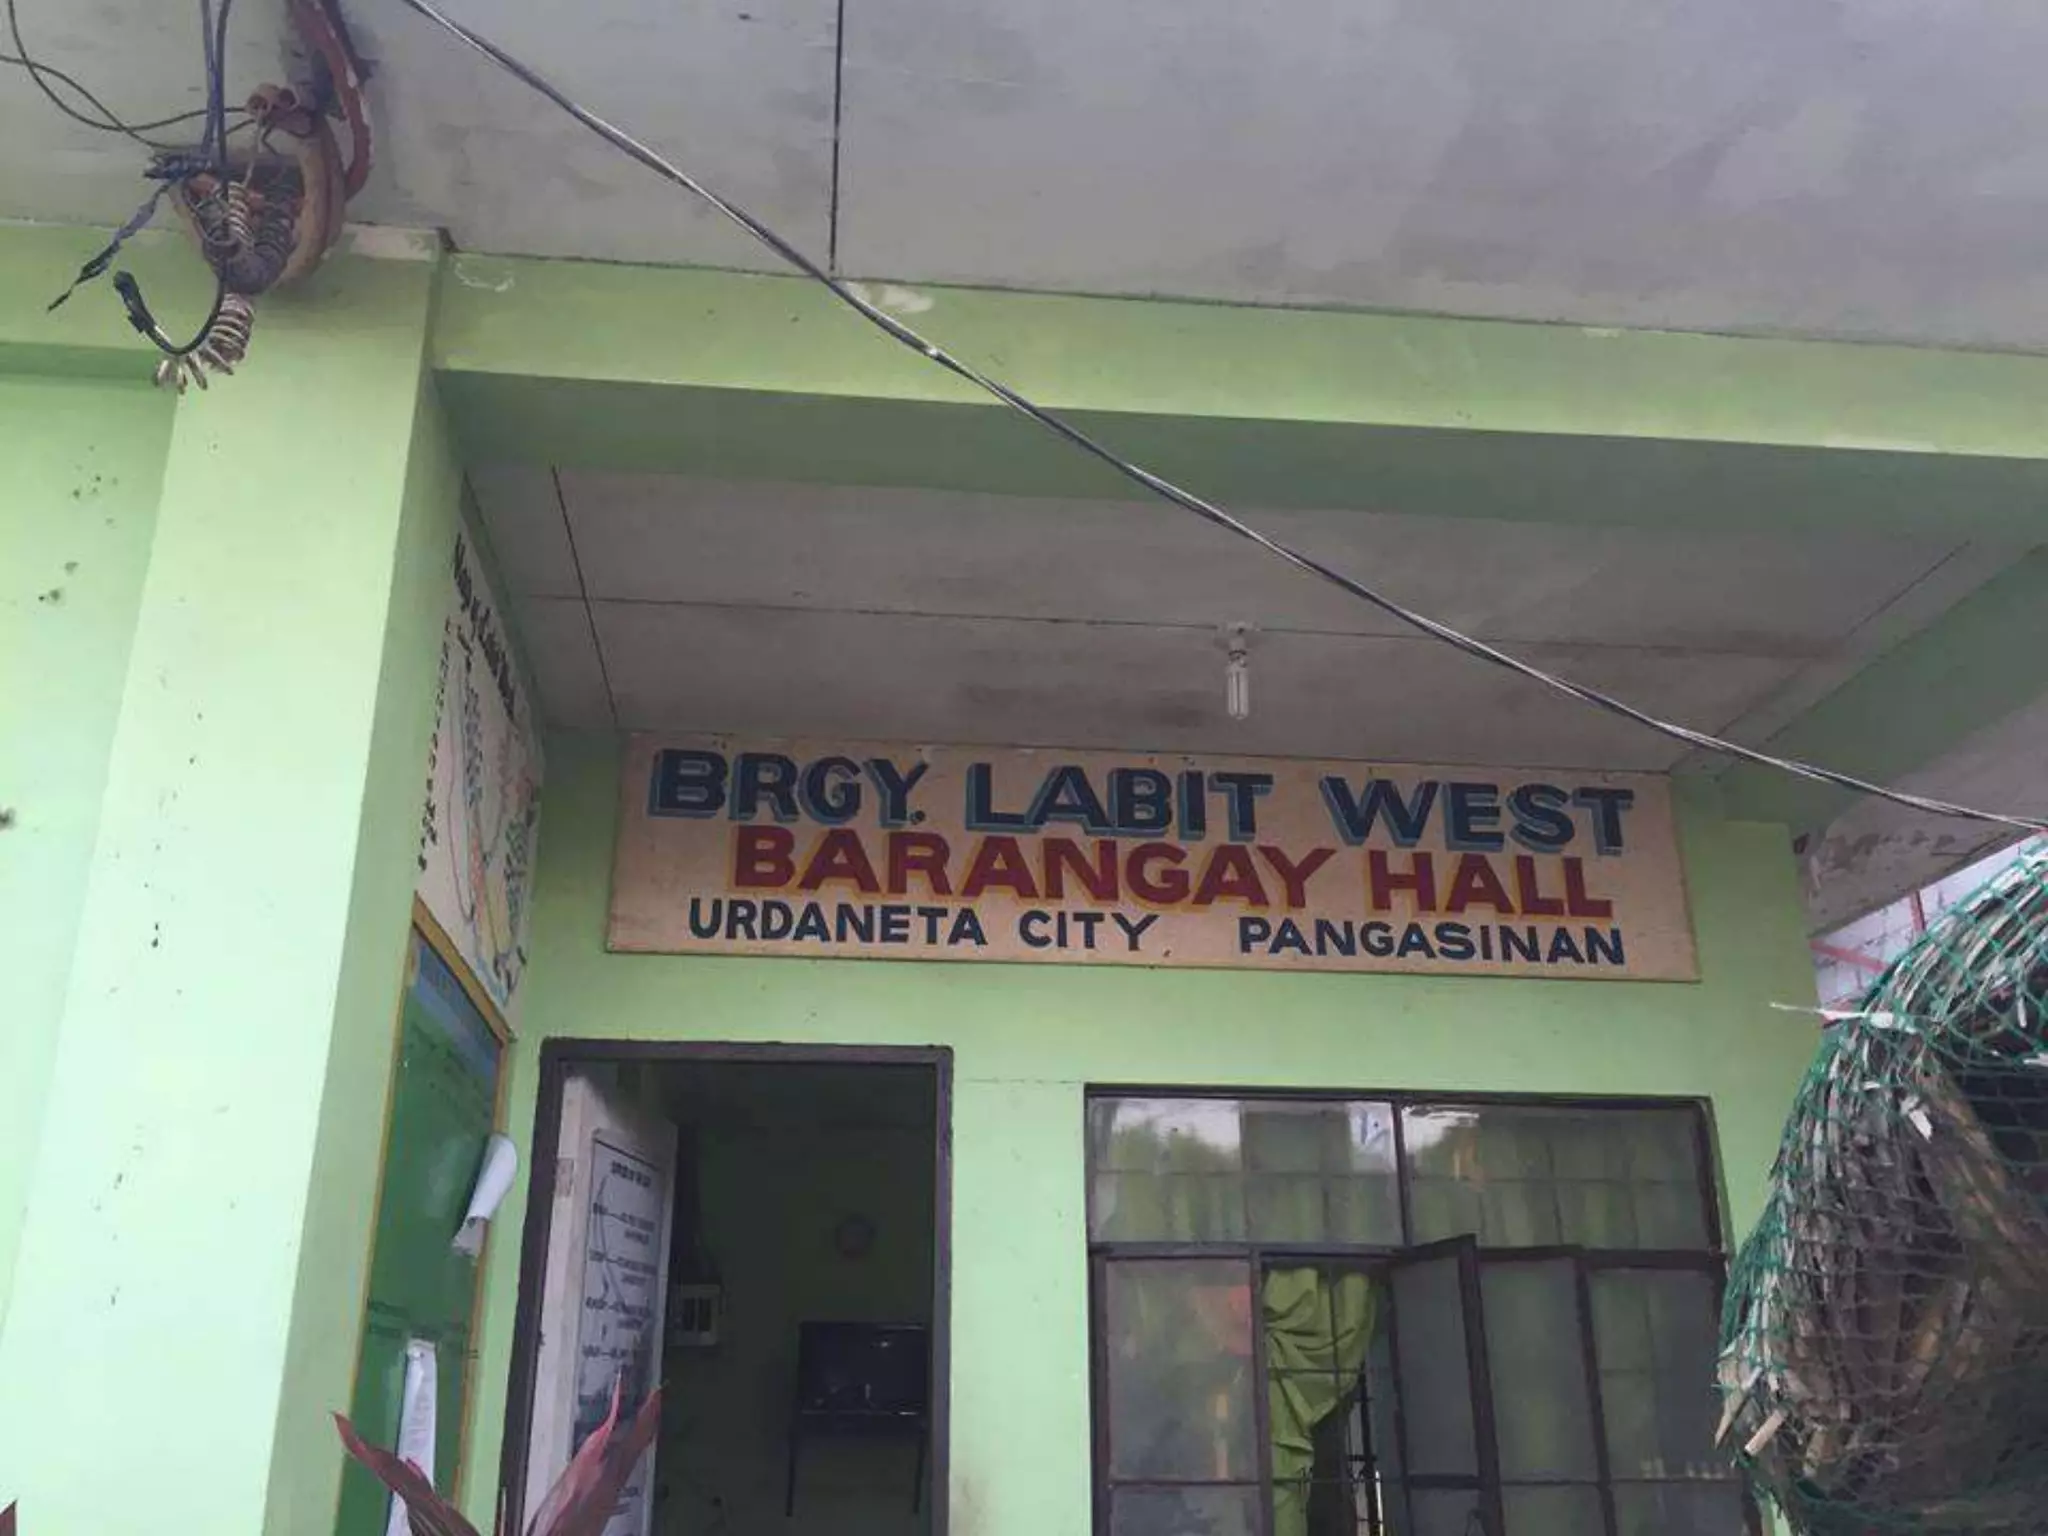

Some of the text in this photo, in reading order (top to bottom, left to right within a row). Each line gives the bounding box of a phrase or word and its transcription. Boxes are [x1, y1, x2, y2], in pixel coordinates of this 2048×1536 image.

[647, 749, 1634, 856] BRGY. LABIT WEST
[729, 825, 1614, 919] BARANGAY HALL
[688, 897, 1625, 965] URDANETA CITY PANGASINAN
